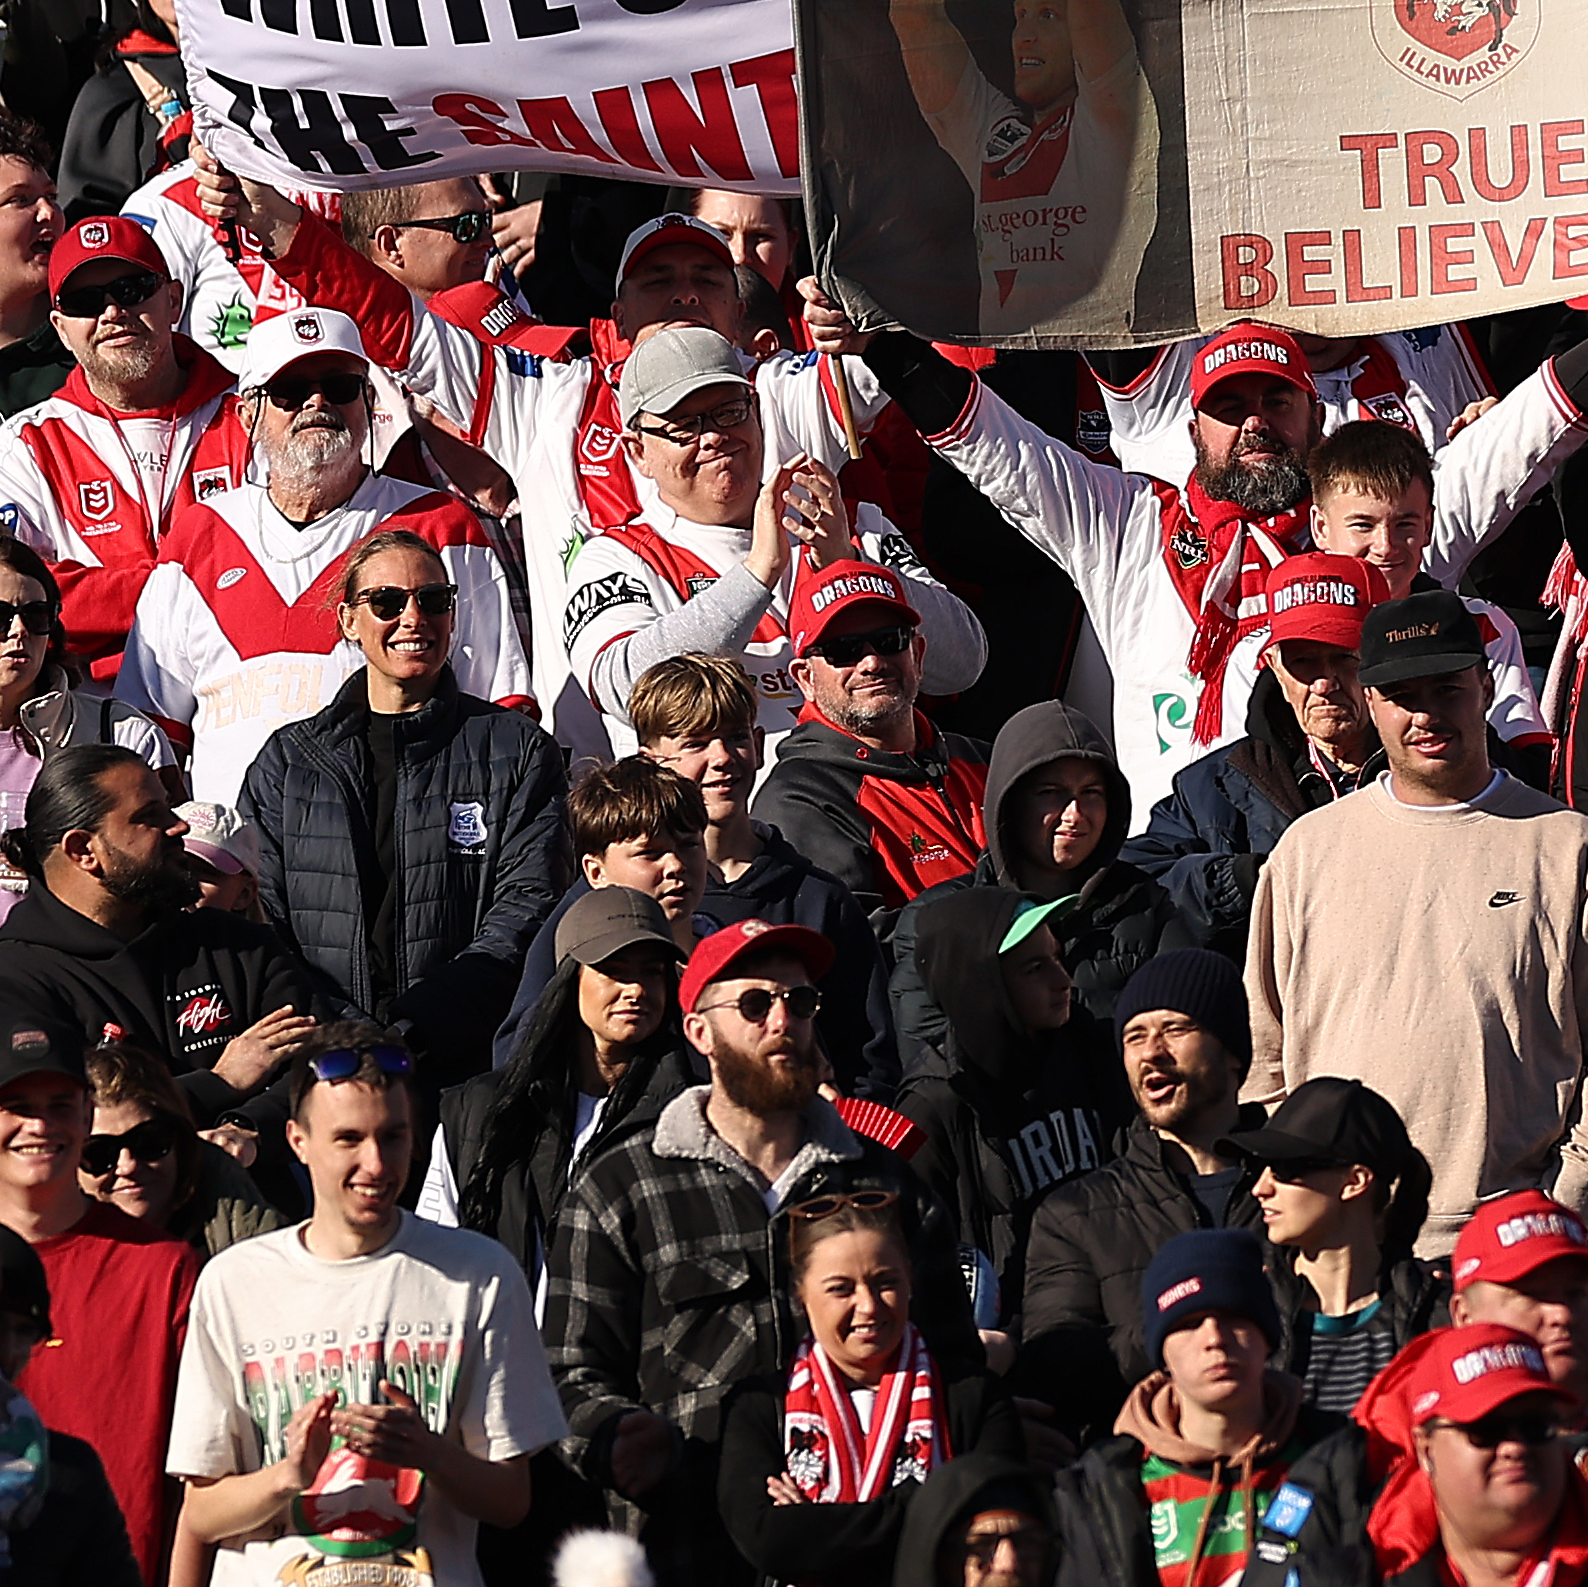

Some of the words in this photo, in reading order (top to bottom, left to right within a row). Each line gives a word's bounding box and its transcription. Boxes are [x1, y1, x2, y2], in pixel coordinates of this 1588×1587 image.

[1397, 41, 1520, 87] ILLAWARRA
[205, 66, 444, 178] THE
[431, 48, 800, 181] SAINT
[980, 203, 1087, 238] st.george
[1010, 237, 1066, 264] bank
[1205, 344, 1290, 374] DRAGONS
[1172, 538, 1206, 561] NRL
[811, 579, 895, 612] DRAGONS
[1273, 583, 1355, 613] DRAGONS
[1385, 624, 1428, 643] Thrills
